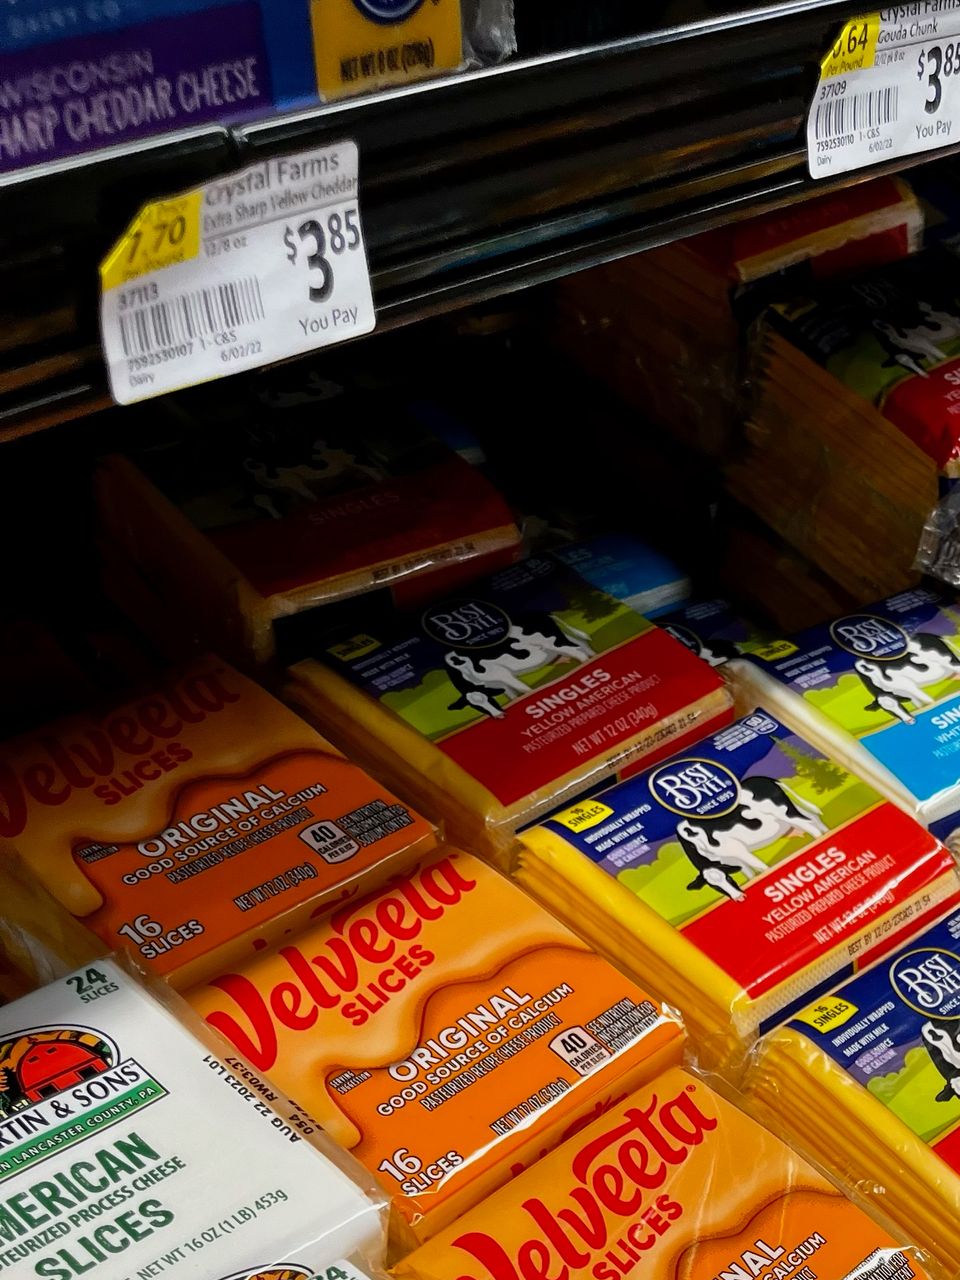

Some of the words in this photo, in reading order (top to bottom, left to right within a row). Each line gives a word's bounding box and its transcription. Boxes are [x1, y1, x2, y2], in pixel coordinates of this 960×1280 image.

[878, 25, 907, 44] Gouda
[910, 18, 938, 37] Chunk
[177, 57, 259, 112] CHEESE
[915, 124, 934, 139] You
[936, 120, 952, 137] Pay
[817, 155, 832, 166] Dairy
[204, 165, 271, 207] Crystal
[277, 152, 339, 185] Farms
[311, 175, 357, 200] Cheddar
[299, 316, 329, 337] You
[332, 306, 359, 327] Pay
[524, 667, 612, 720] SINGLES
[137, 784, 285, 858] ORIGINAL
[763, 846, 847, 903] SINGLES
[119, 914, 162, 946] 16
[140, 919, 205, 961] SLICES
[66, 968, 108, 996] 24
[205, 860, 477, 1073] Velveeta
[80, 981, 119, 1004] SLICES
[341, 943, 436, 1027] SLICES
[376, 1076, 427, 1117] GOOD
[428, 1040, 490, 1089] SOURCE
[487, 1025, 512, 1048] OF
[508, 982, 575, 1032] CALCIUM
[387, 984, 534, 1084] ORIGINAL
[560, 1032, 585, 1054] 40
[202, 1055, 227, 1075] L01
[225, 1057, 279, 1102] RW03:37
[224, 1074, 256, 1101] 2023
[254, 1101, 273, 1117] 22
[270, 1117, 302, 1143] AUG
[377, 1148, 421, 1184] 16
[401, 1151, 465, 1198] SLICES
